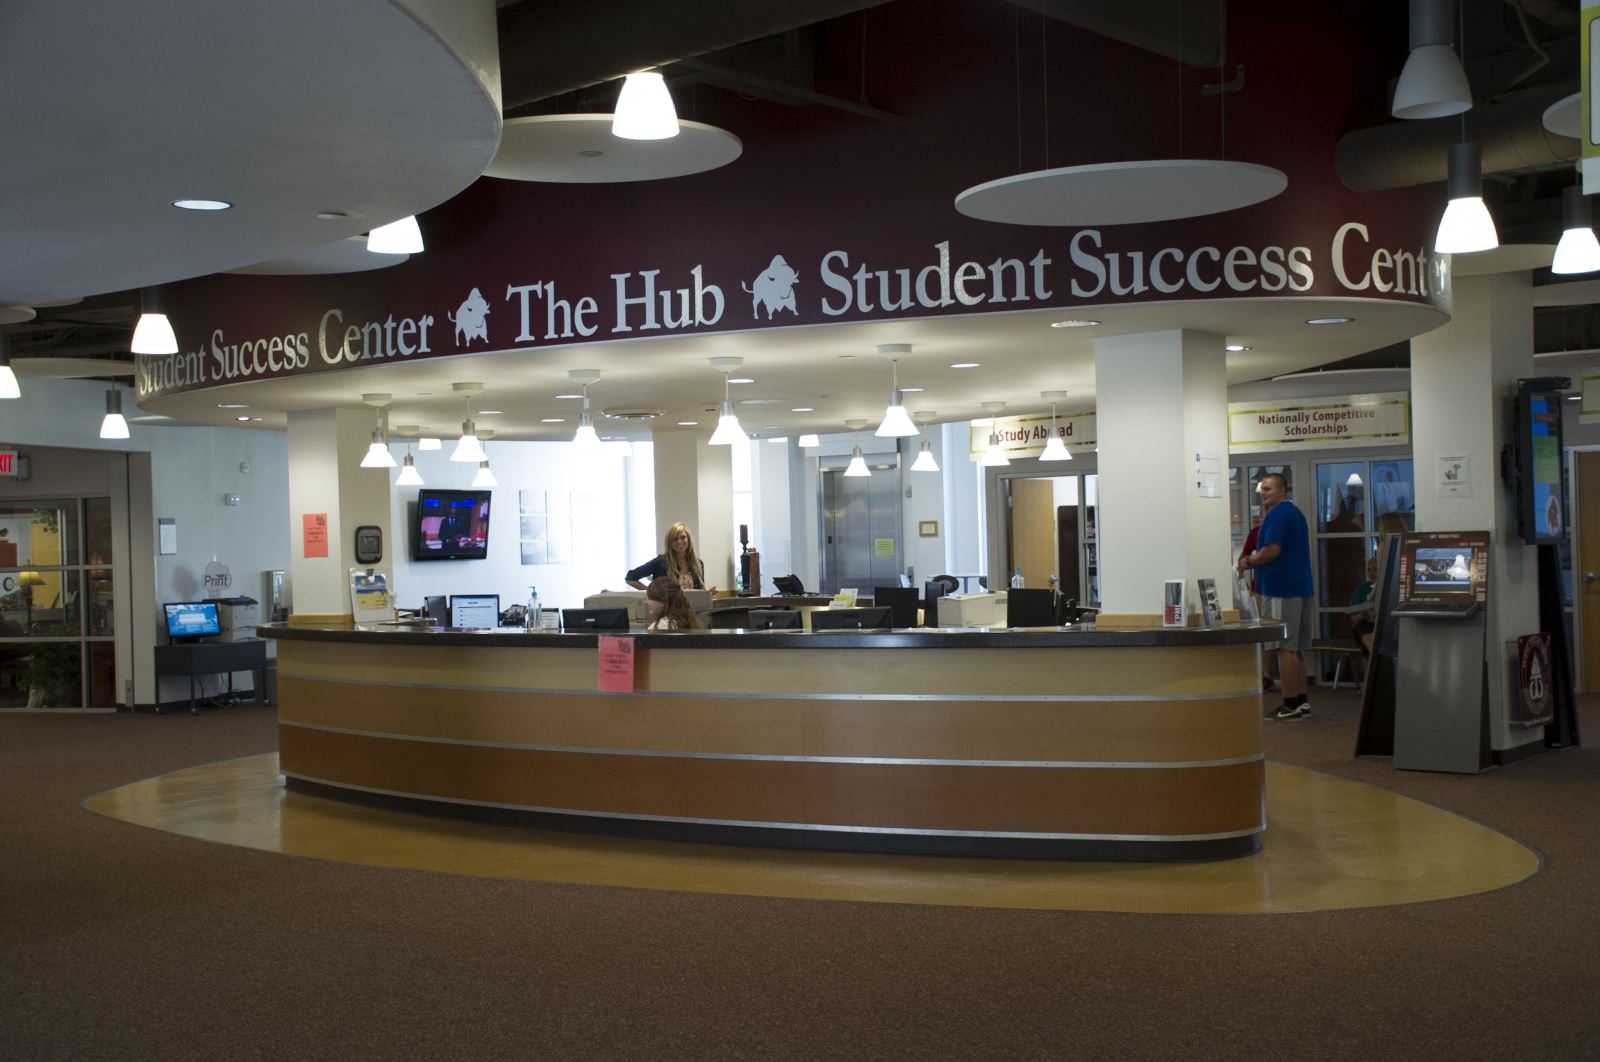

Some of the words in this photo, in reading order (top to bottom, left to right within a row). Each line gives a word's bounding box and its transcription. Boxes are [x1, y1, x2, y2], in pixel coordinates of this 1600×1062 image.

[139, 344, 207, 395] Student
[211, 329, 310, 380] Success
[318, 308, 435, 364] Center
[505, 279, 599, 342] The
[610, 264, 725, 333] Hub
[820, 240, 1053, 316] Student
[1069, 229, 1314, 298] Success
[1258, 411, 1311, 425] Nationally
[1312, 407, 1376, 422] Competitive
[998, 427, 1031, 444] Study
[1033, 422, 1073, 440] Abad
[1284, 423, 1348, 436] Scholarships
[0, 453, 13, 472] XIT
